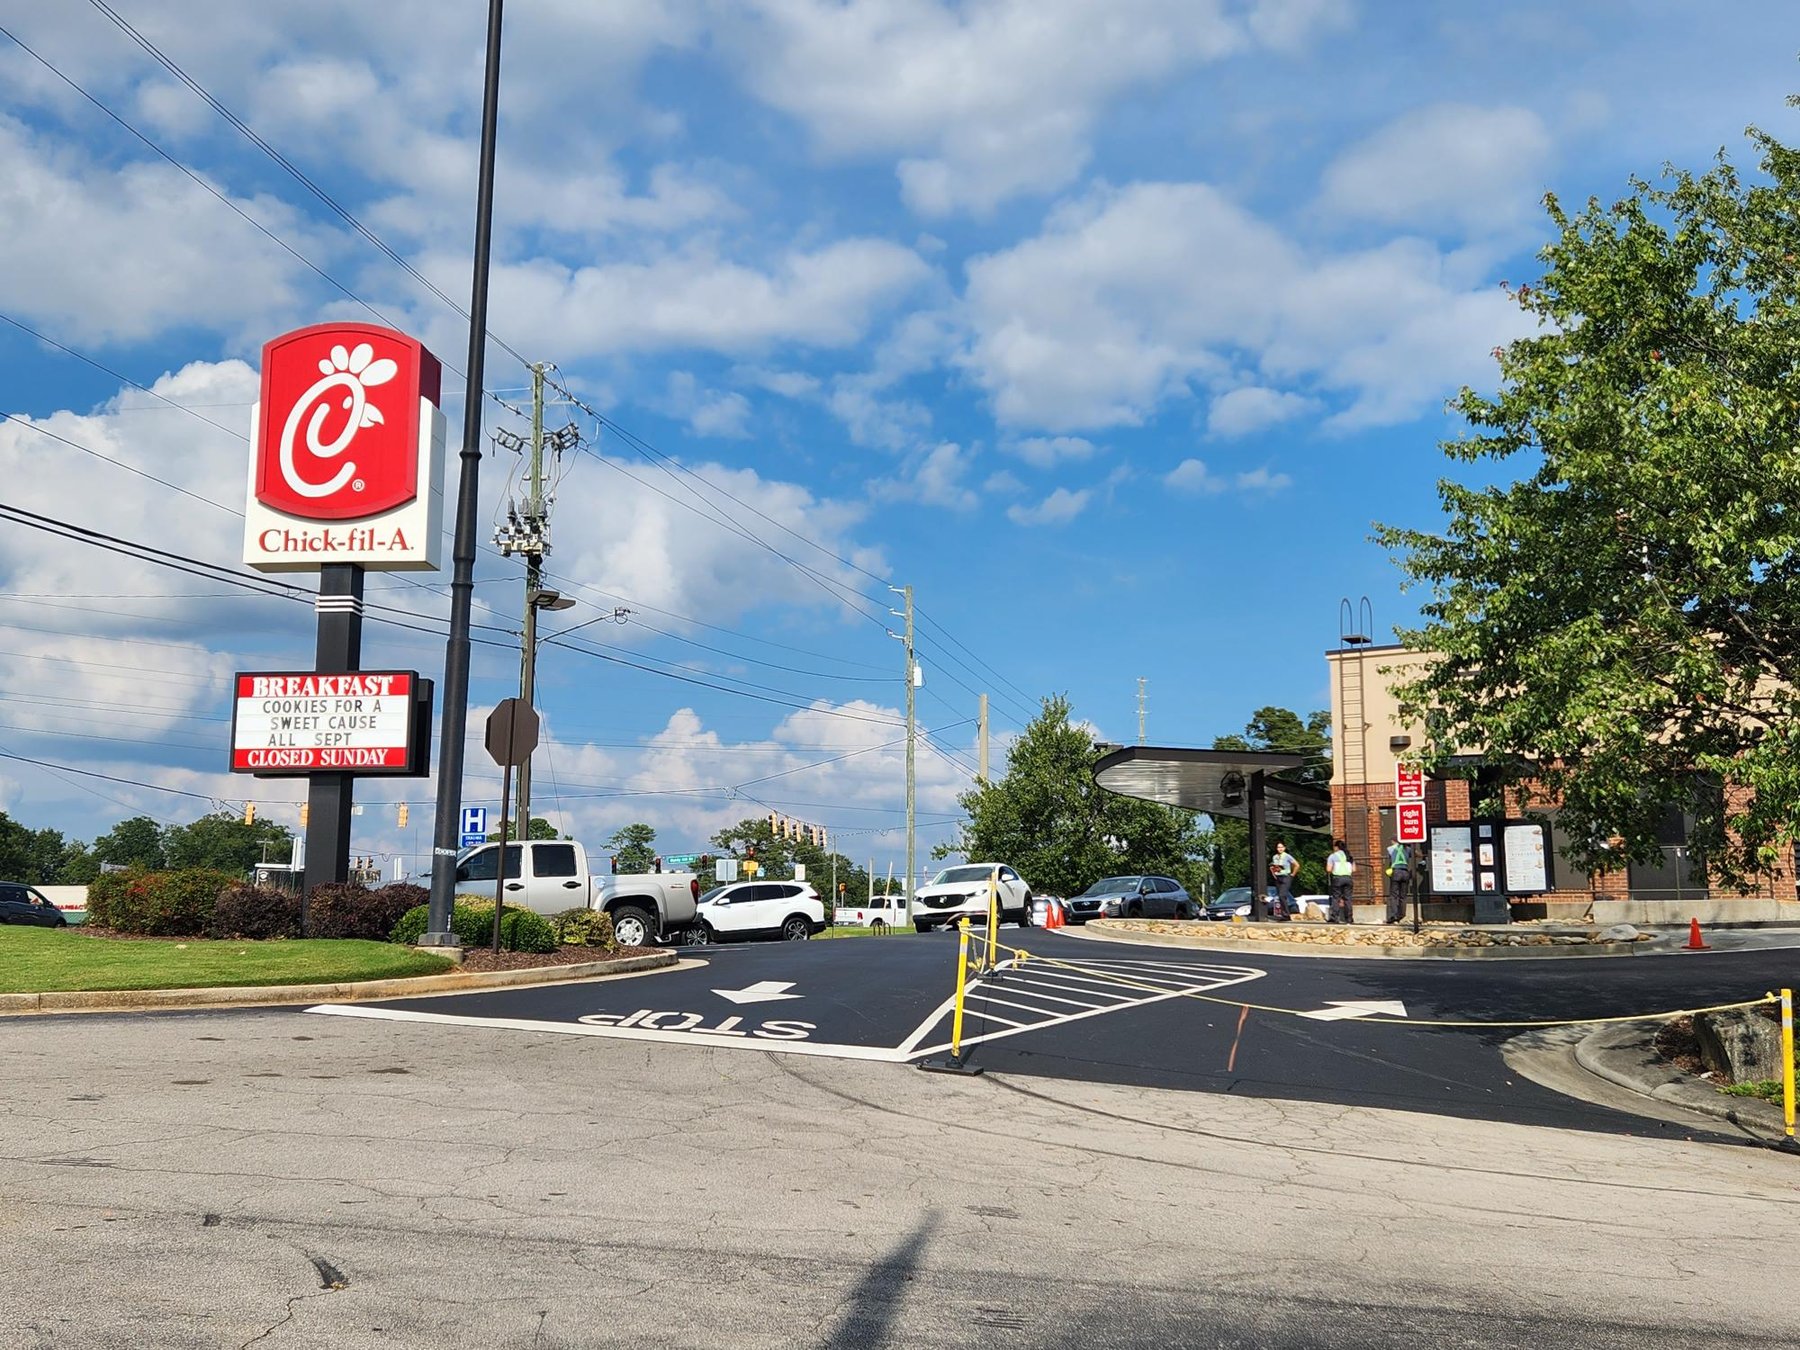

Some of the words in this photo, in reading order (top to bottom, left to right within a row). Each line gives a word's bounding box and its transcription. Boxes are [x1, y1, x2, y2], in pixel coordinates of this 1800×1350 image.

[258, 527, 409, 553] Chick-fil-A
[251, 675, 394, 698] BREAKFAST
[262, 700, 328, 714] COOKIES
[335, 699, 363, 713] FOR
[372, 699, 382, 713] A
[270, 716, 320, 730] SWEET
[328, 715, 377, 729] CAUSE
[268, 733, 296, 747] ALL
[314, 732, 353, 746] SEPT
[247, 749, 314, 767] CLOSED
[320, 748, 389, 766] SUNDAY
[464, 809, 484, 832] H
[1402, 810, 1419, 818] right
[1404, 826, 1419, 835] only
[577, 1008, 818, 1040] STOP
